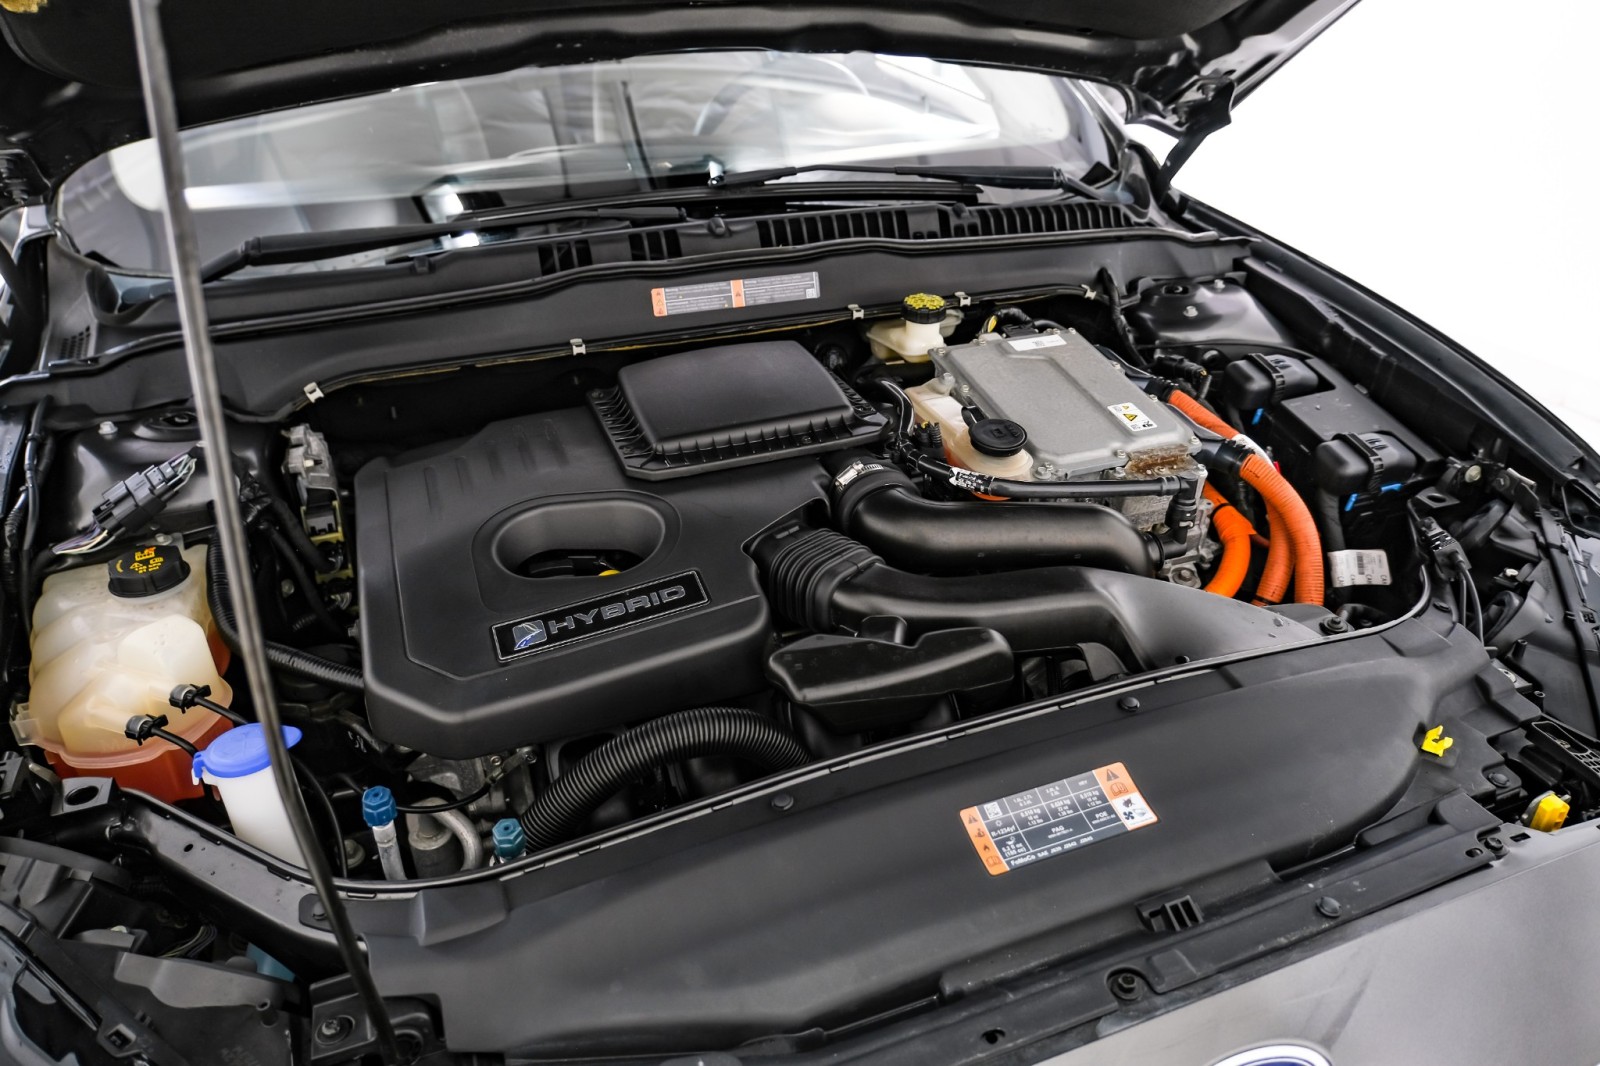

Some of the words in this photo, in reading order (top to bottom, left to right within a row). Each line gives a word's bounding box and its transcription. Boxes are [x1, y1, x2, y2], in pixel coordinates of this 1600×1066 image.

[549, 585, 686, 634] HYBRID
[991, 825, 1015, 837] R-1234yf
[1011, 855, 1035, 866] FoMoCo
